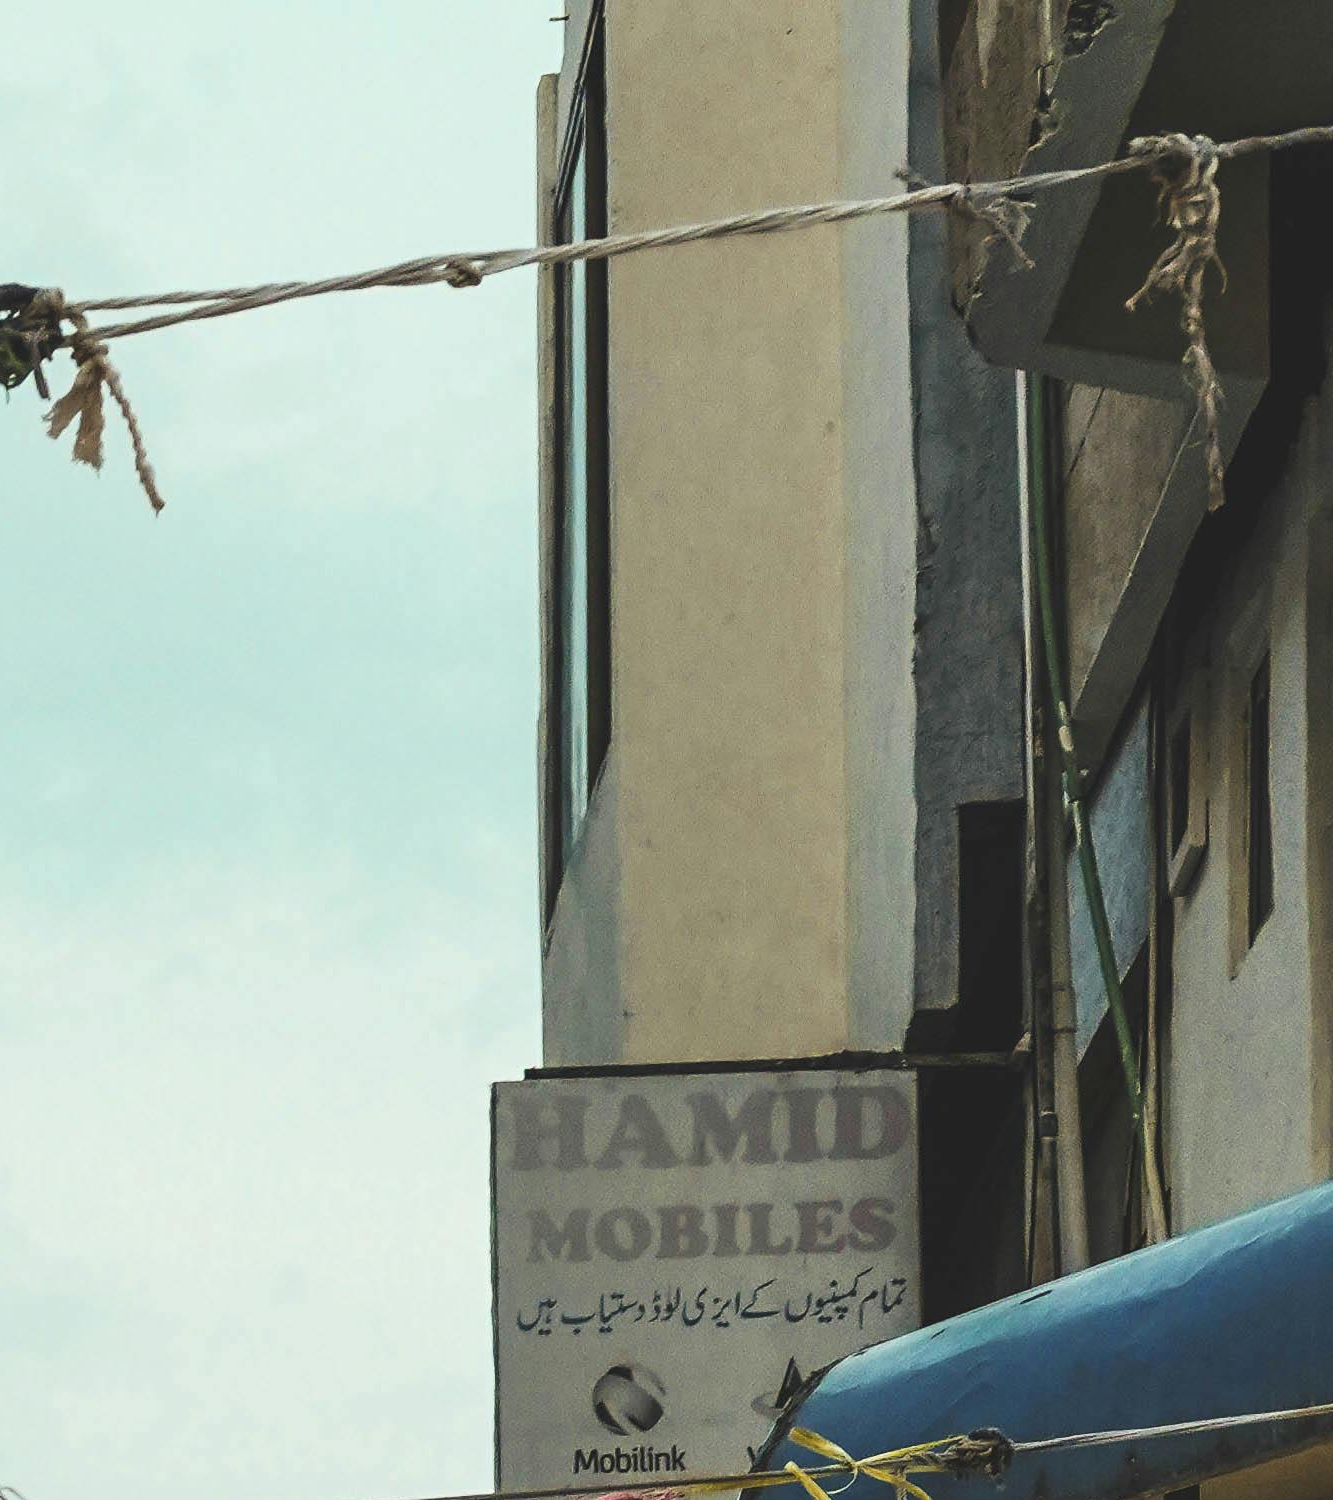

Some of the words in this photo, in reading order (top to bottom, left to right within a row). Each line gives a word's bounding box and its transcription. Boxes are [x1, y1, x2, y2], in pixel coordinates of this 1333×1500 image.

[507, 1087, 909, 1171] HAMID
[528, 1200, 897, 1263] MOBILES
[741, 1279, 779, 1318] کے
[858, 1278, 906, 1329] تمام
[573, 1445, 685, 1474] Mobilink
